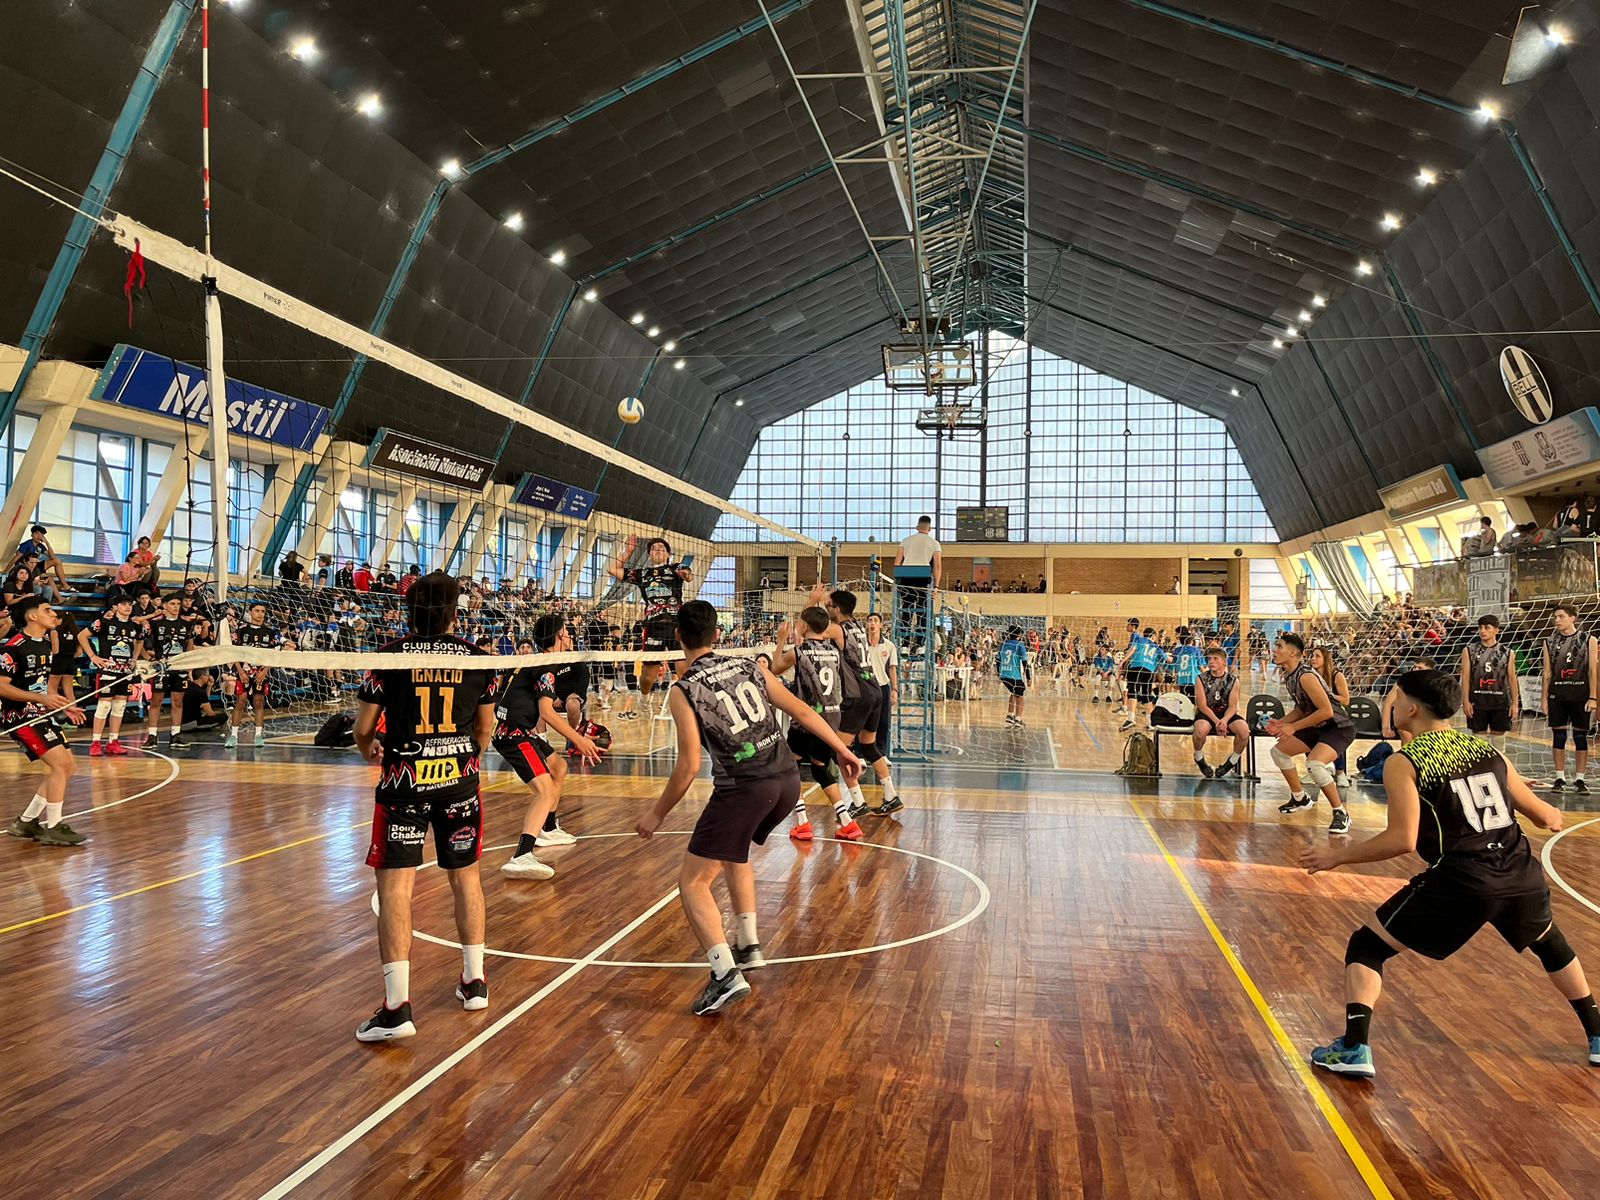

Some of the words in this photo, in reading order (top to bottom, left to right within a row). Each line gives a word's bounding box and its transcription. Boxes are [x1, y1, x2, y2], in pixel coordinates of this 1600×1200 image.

[1512, 377, 1537, 396] BELL
[437, 457, 469, 479] Mutual
[402, 642, 431, 651] CLUB
[432, 642, 471, 652] SOCIAL
[1566, 652, 1572, 663] 2
[1484, 662, 1492, 673] 5
[411, 669, 463, 684] IGNACIO
[819, 666, 834, 696] 9
[1214, 691, 1220, 700] 8
[415, 686, 457, 734] 11
[715, 680, 767, 735] 10
[422, 742, 474, 757] NORTE
[1449, 771, 1514, 833] 19
